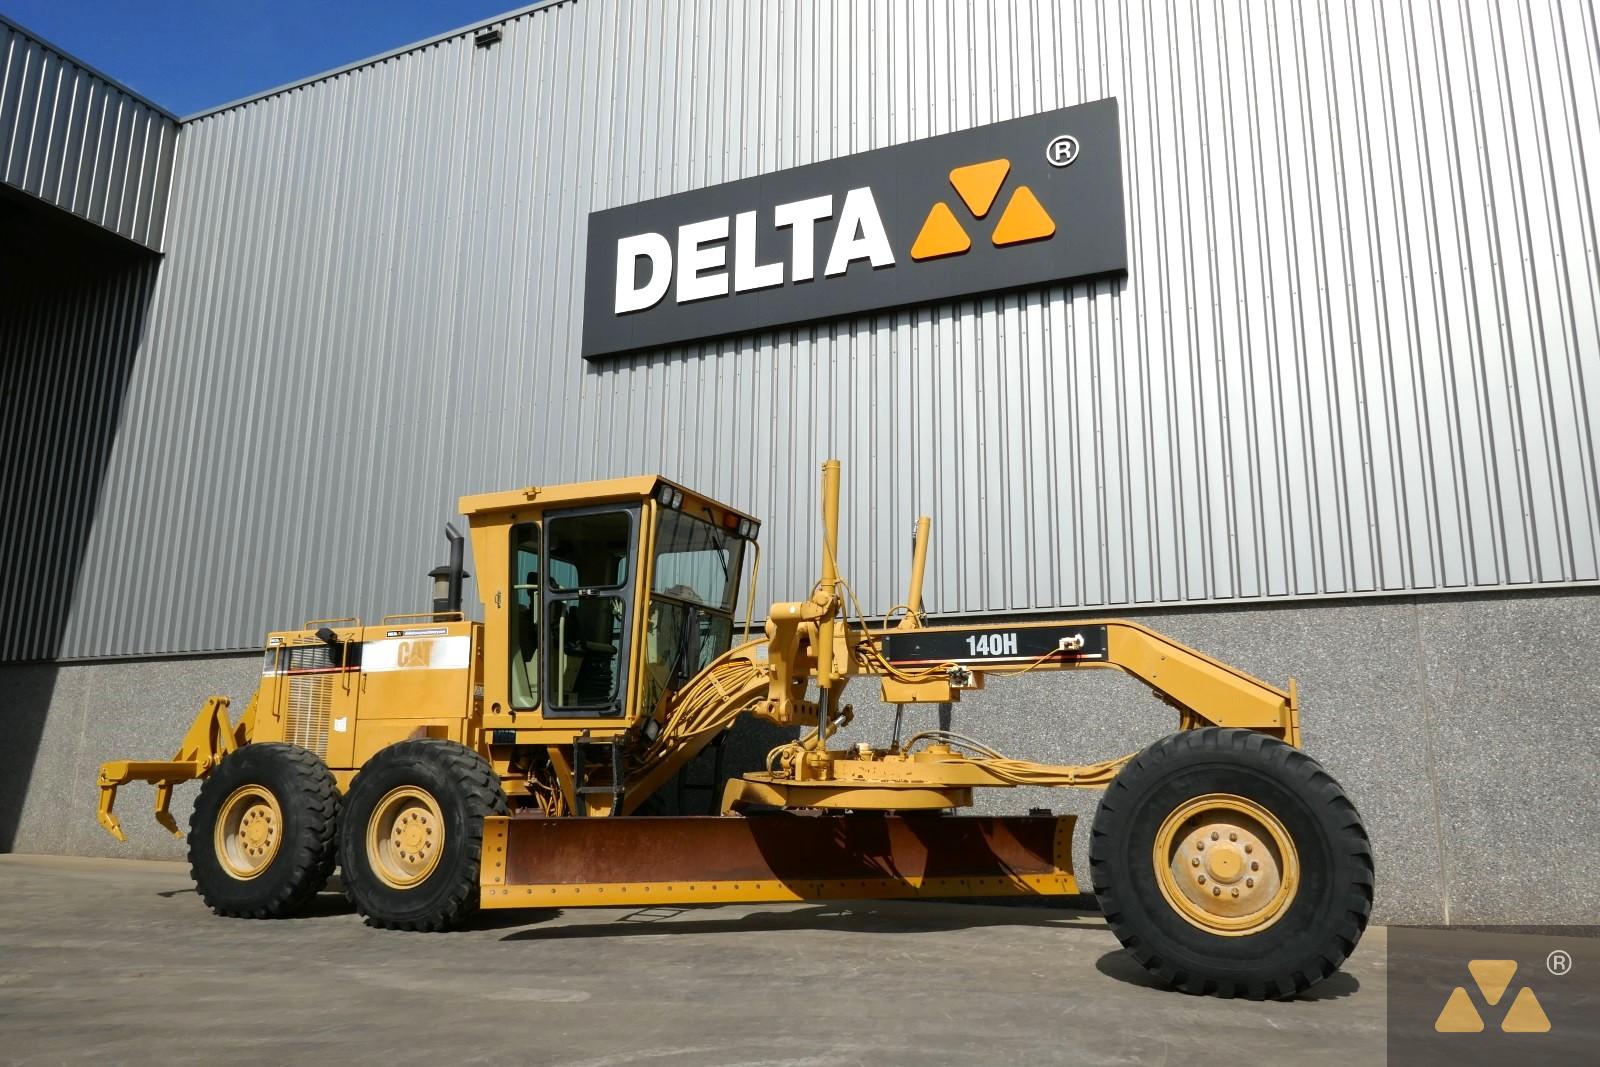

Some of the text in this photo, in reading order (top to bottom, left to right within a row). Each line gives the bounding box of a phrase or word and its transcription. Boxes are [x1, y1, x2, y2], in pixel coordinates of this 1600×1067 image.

[614, 186, 896, 314] DELTA
[397, 640, 434, 667] CAT
[966, 632, 1018, 656] 140H
